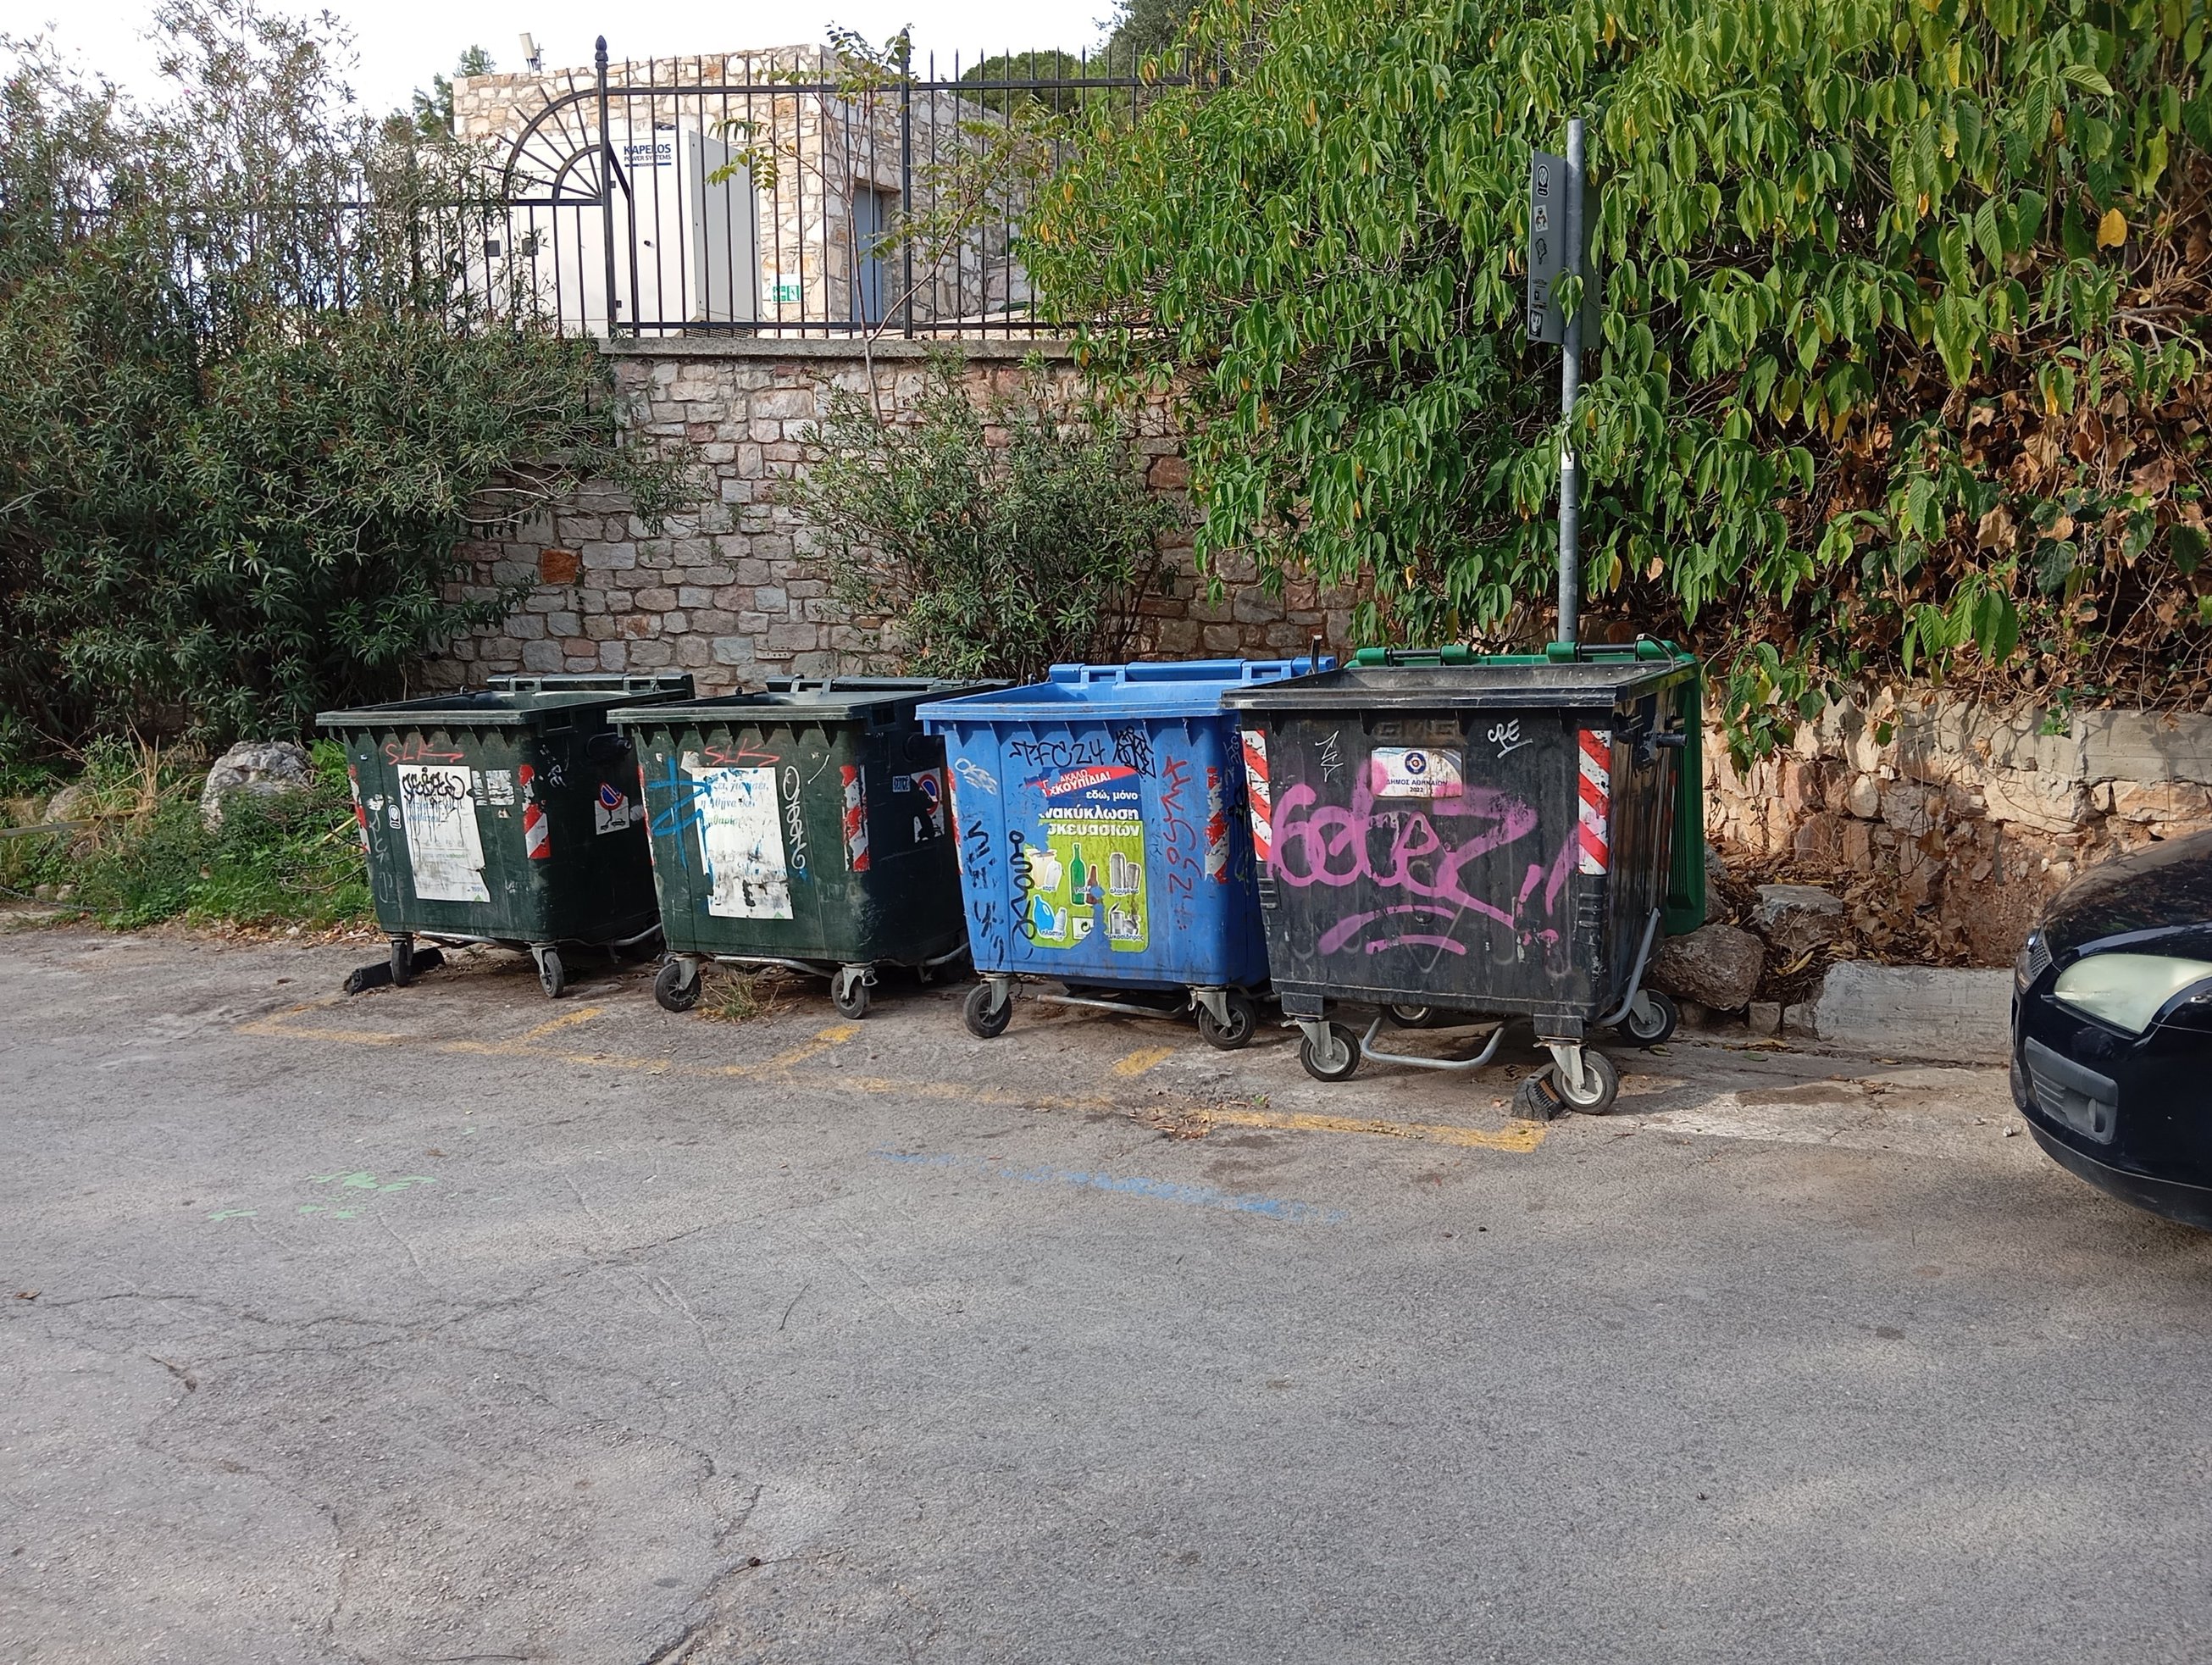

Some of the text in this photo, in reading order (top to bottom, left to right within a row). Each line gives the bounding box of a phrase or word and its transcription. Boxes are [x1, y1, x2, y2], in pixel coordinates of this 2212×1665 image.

[624, 143, 672, 155] KAPELOS
[1085, 790, 1139, 802] εδώ, μόνο
[1039, 821, 1140, 837] σκευασιών
